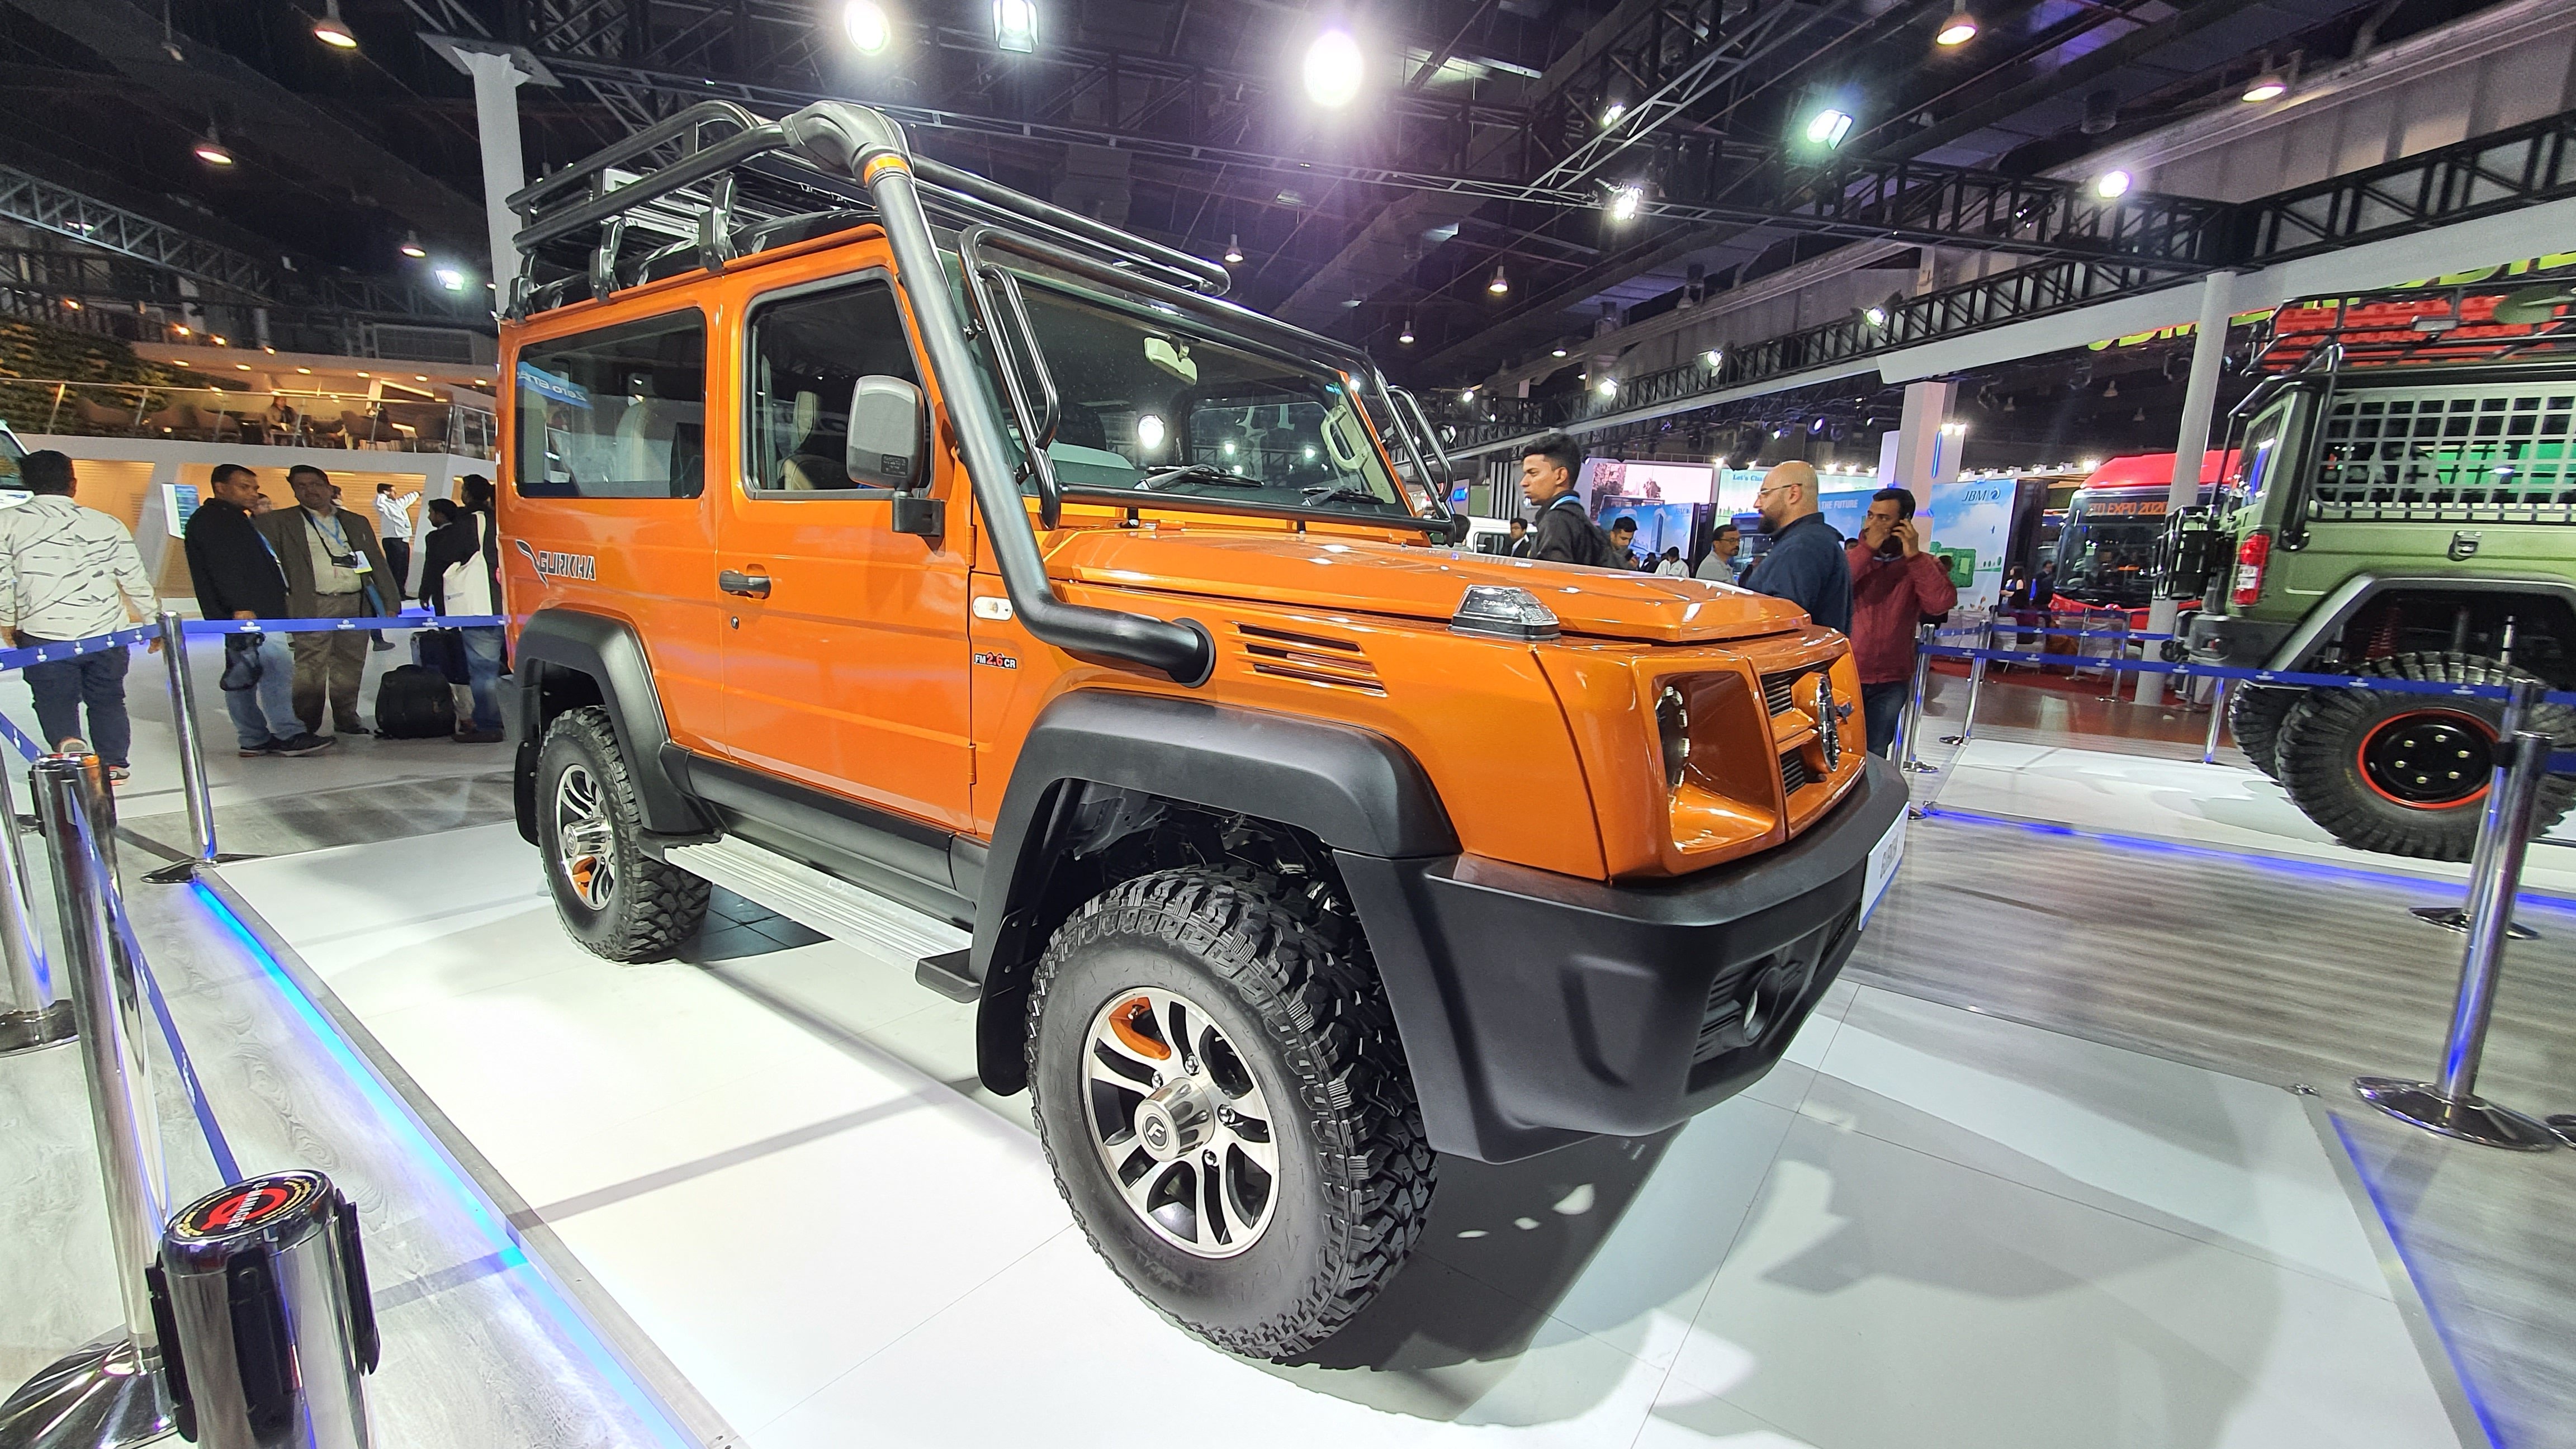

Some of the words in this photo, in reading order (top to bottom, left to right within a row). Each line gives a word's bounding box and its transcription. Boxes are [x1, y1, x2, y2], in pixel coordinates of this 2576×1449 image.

[1962, 490, 1987, 501] JBM
[1821, 501, 1833, 509] THE
[1834, 499, 1859, 509] FUTURE
[2108, 502, 2137, 515] EXPO
[538, 550, 596, 581] GURKHA
